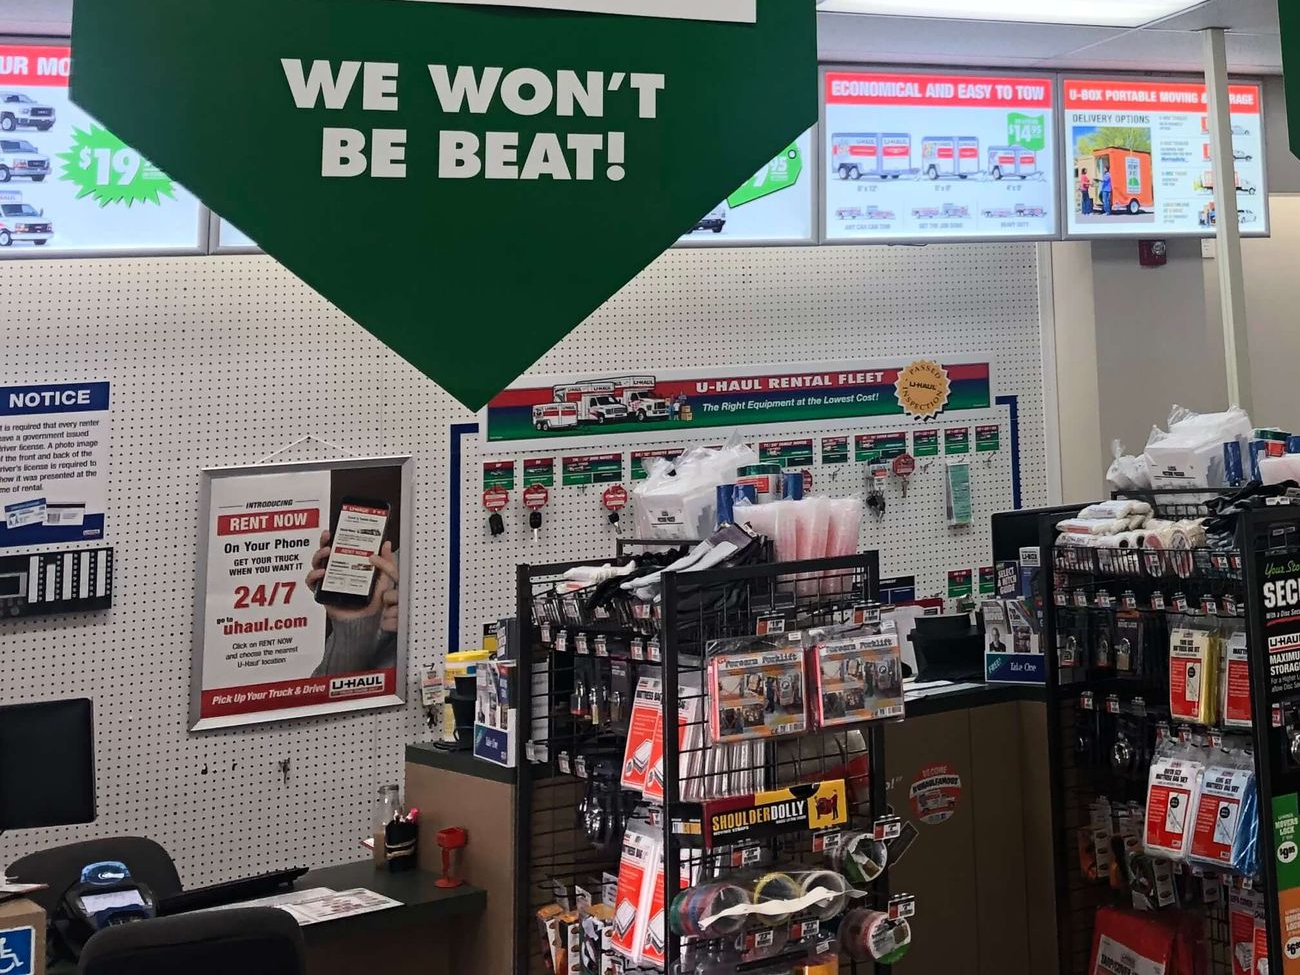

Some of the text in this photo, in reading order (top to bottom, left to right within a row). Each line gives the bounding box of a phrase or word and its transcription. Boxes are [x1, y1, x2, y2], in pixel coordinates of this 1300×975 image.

[281, 58, 665, 119] WE WON'T
[832, 80, 1044, 101] ECONOMICAL AND EASY TO TOW
[1070, 89, 1198, 103] U-BOX PORTABLE MOVING
[1072, 114, 1112, 123] DELIVERY
[1115, 115, 1150, 124] OPTIONS
[322, 128, 626, 182] BE BEAT!
[696, 373, 884, 393] U-HAUL RENTAL FLEET
[9, 390, 90, 408] NOTICE
[703, 393, 879, 412] The Right Equipment at the Lowest Cost!
[246, 499, 293, 509] INTRODUCING
[230, 513, 307, 531] RENT NOW
[224, 539, 309, 553] On Your Phone
[234, 582, 296, 609] 24/7
[224, 616, 307, 635] uhaul.com
[332, 676, 382, 689] U-HAUL
[212, 696, 232, 705] Pick
[234, 694, 245, 704] Up
[248, 692, 266, 701] Your
[269, 688, 292, 698] Truck
[295, 687, 302, 695] &
[303, 685, 325, 693] Drive
